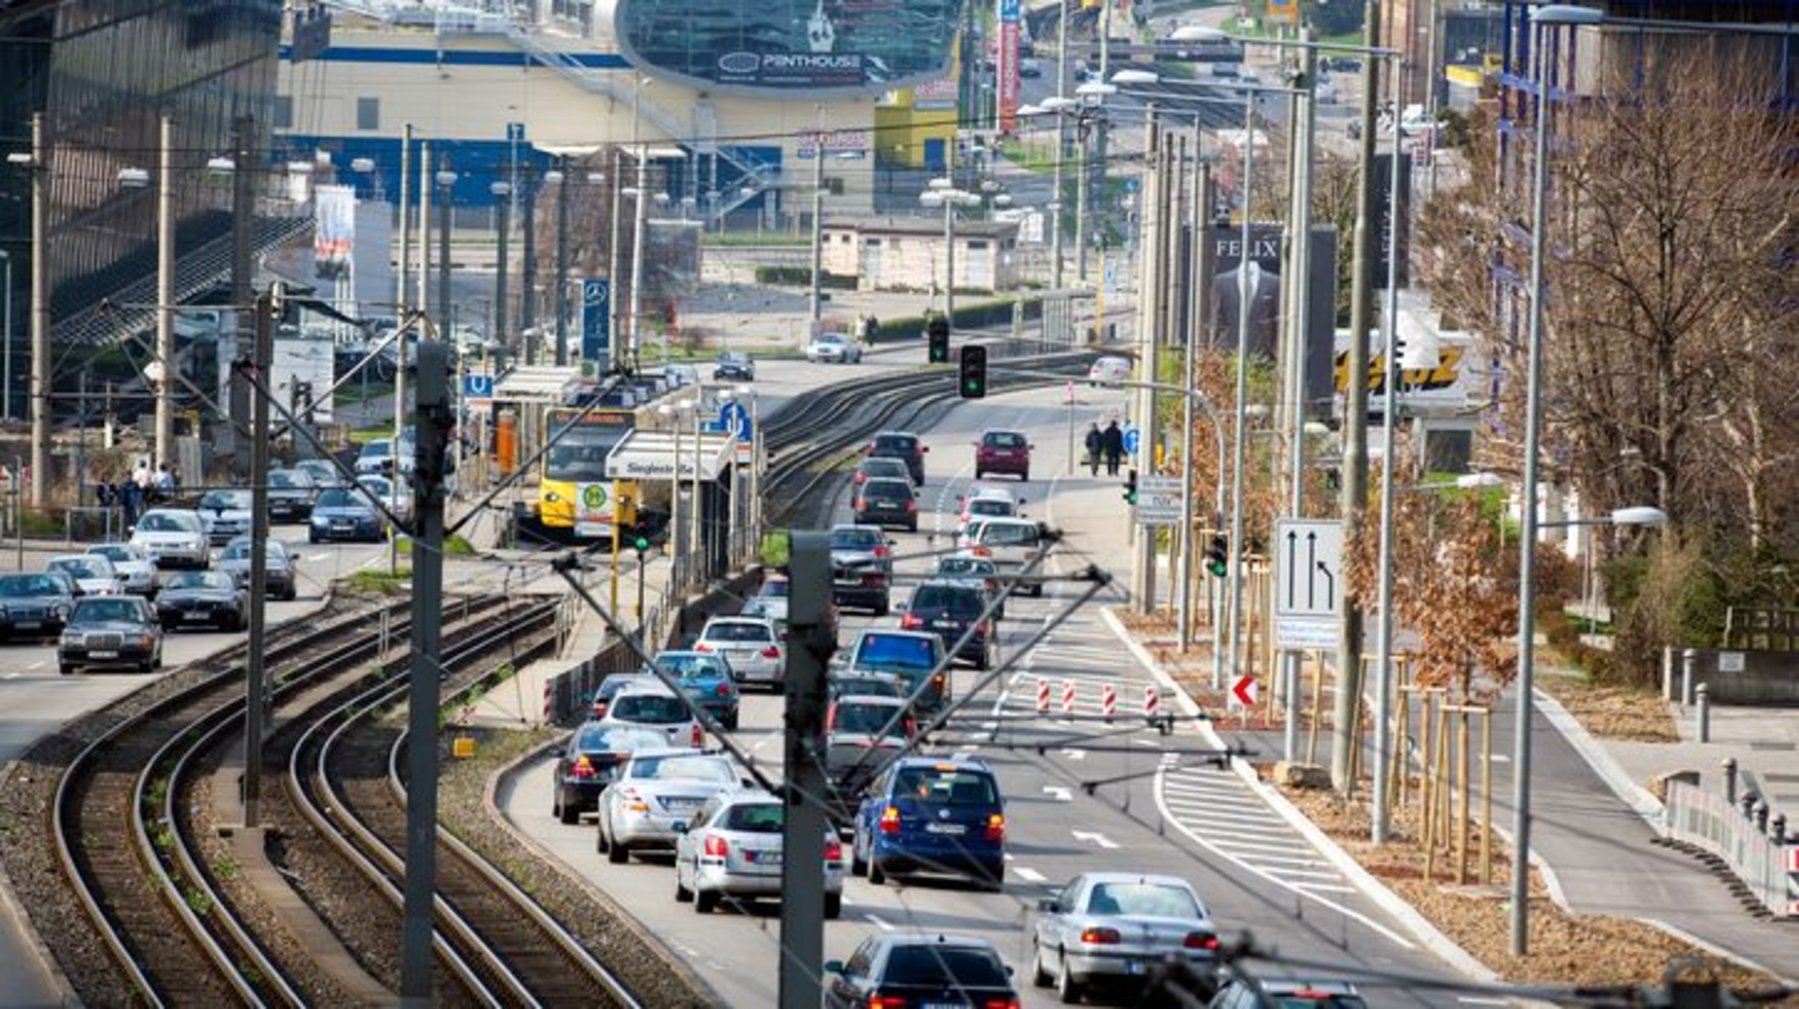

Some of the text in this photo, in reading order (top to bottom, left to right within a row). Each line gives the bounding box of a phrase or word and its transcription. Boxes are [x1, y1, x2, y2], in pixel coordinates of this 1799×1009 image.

[763, 54, 861, 68] PENTHOUSE
[1216, 240, 1277, 257] FEIX
[471, 376, 486, 393] U
